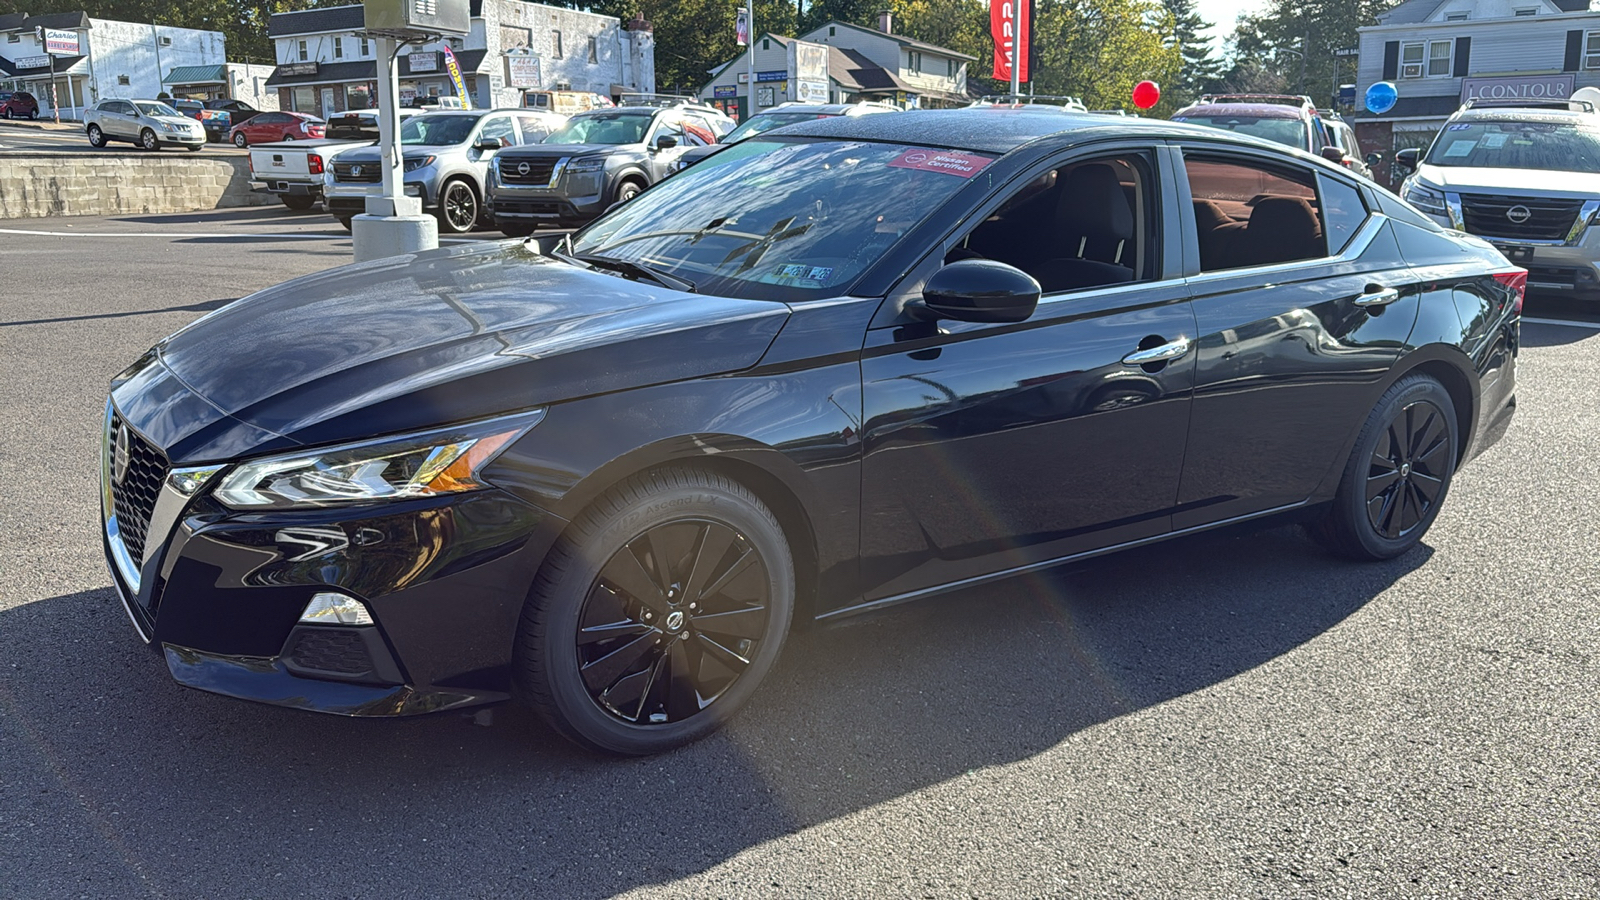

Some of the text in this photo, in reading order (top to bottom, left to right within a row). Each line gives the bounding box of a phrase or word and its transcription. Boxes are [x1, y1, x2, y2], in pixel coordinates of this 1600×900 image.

[1479, 82, 1565, 99] CONTOUR
[927, 160, 973, 172] Certified
[933, 155, 969, 165] Nissan
[646, 494, 694, 515] Ascend
